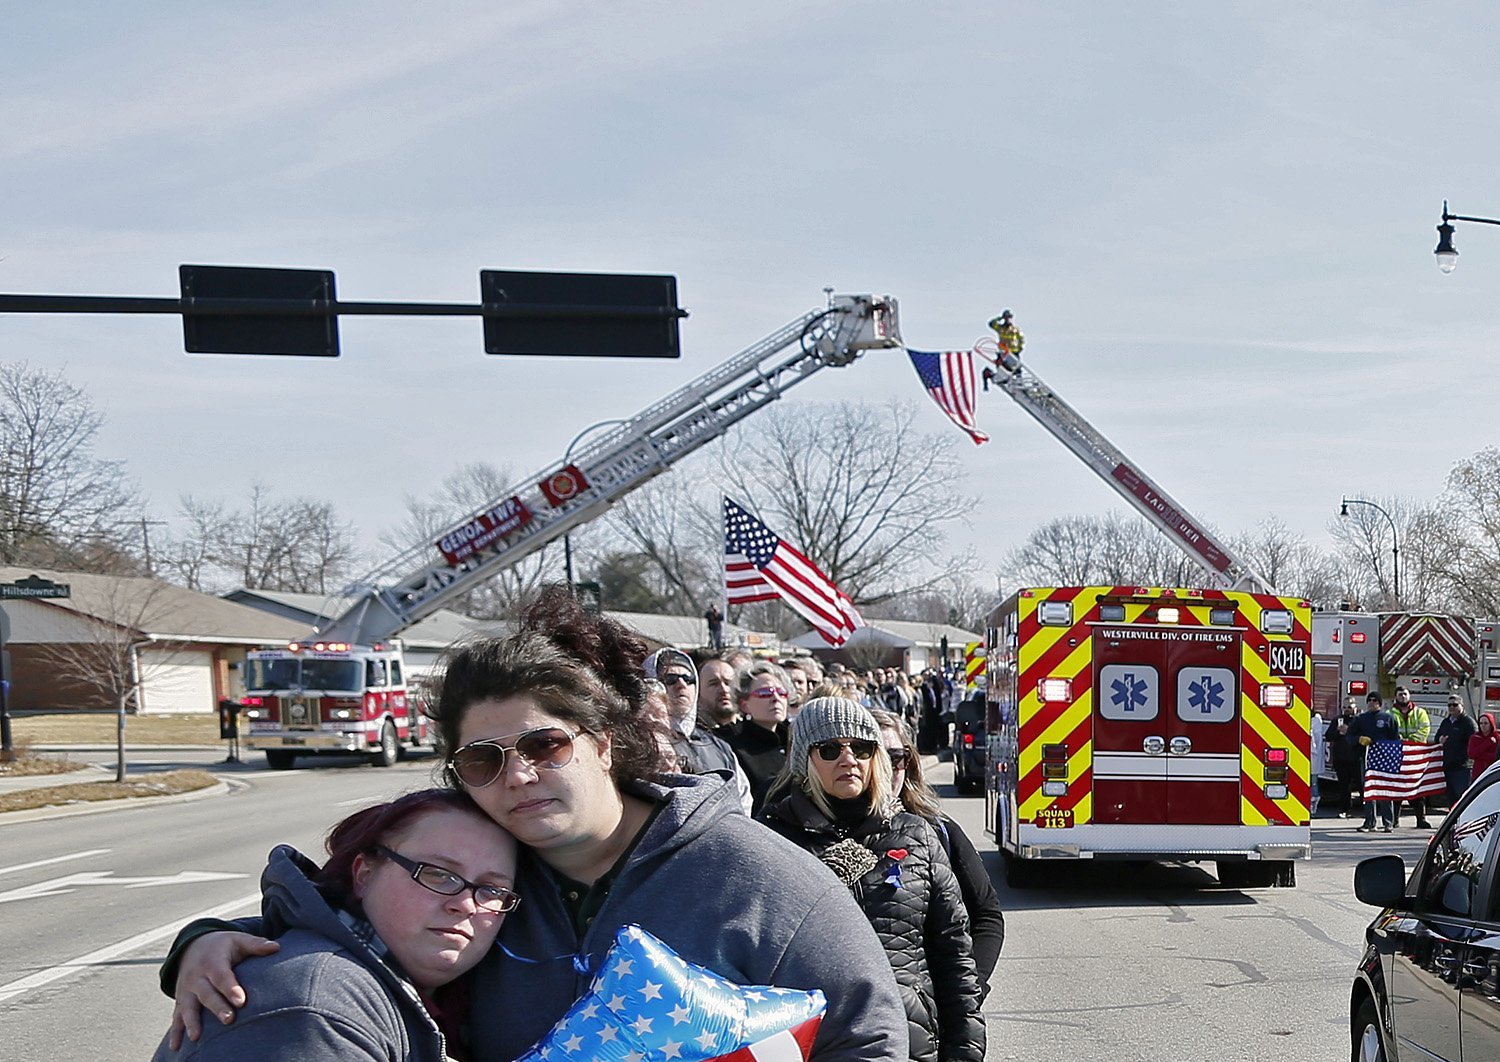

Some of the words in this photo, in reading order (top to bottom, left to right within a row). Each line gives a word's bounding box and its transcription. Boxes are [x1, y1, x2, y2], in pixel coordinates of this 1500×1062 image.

[440, 520, 485, 553] GENOA
[487, 501, 522, 526] TWP.
[3, 586, 55, 596] Hillsdowne
[1102, 630, 1160, 640] WESTERVILLE
[1161, 632, 1180, 641] DIV.
[1181, 633, 1194, 641] OF
[1195, 633, 1233, 643] FIRE/EMS
[1271, 646, 1304, 675] SQ-113
[1038, 810, 1071, 818] SQUAD
[1045, 818, 1066, 828] 113
